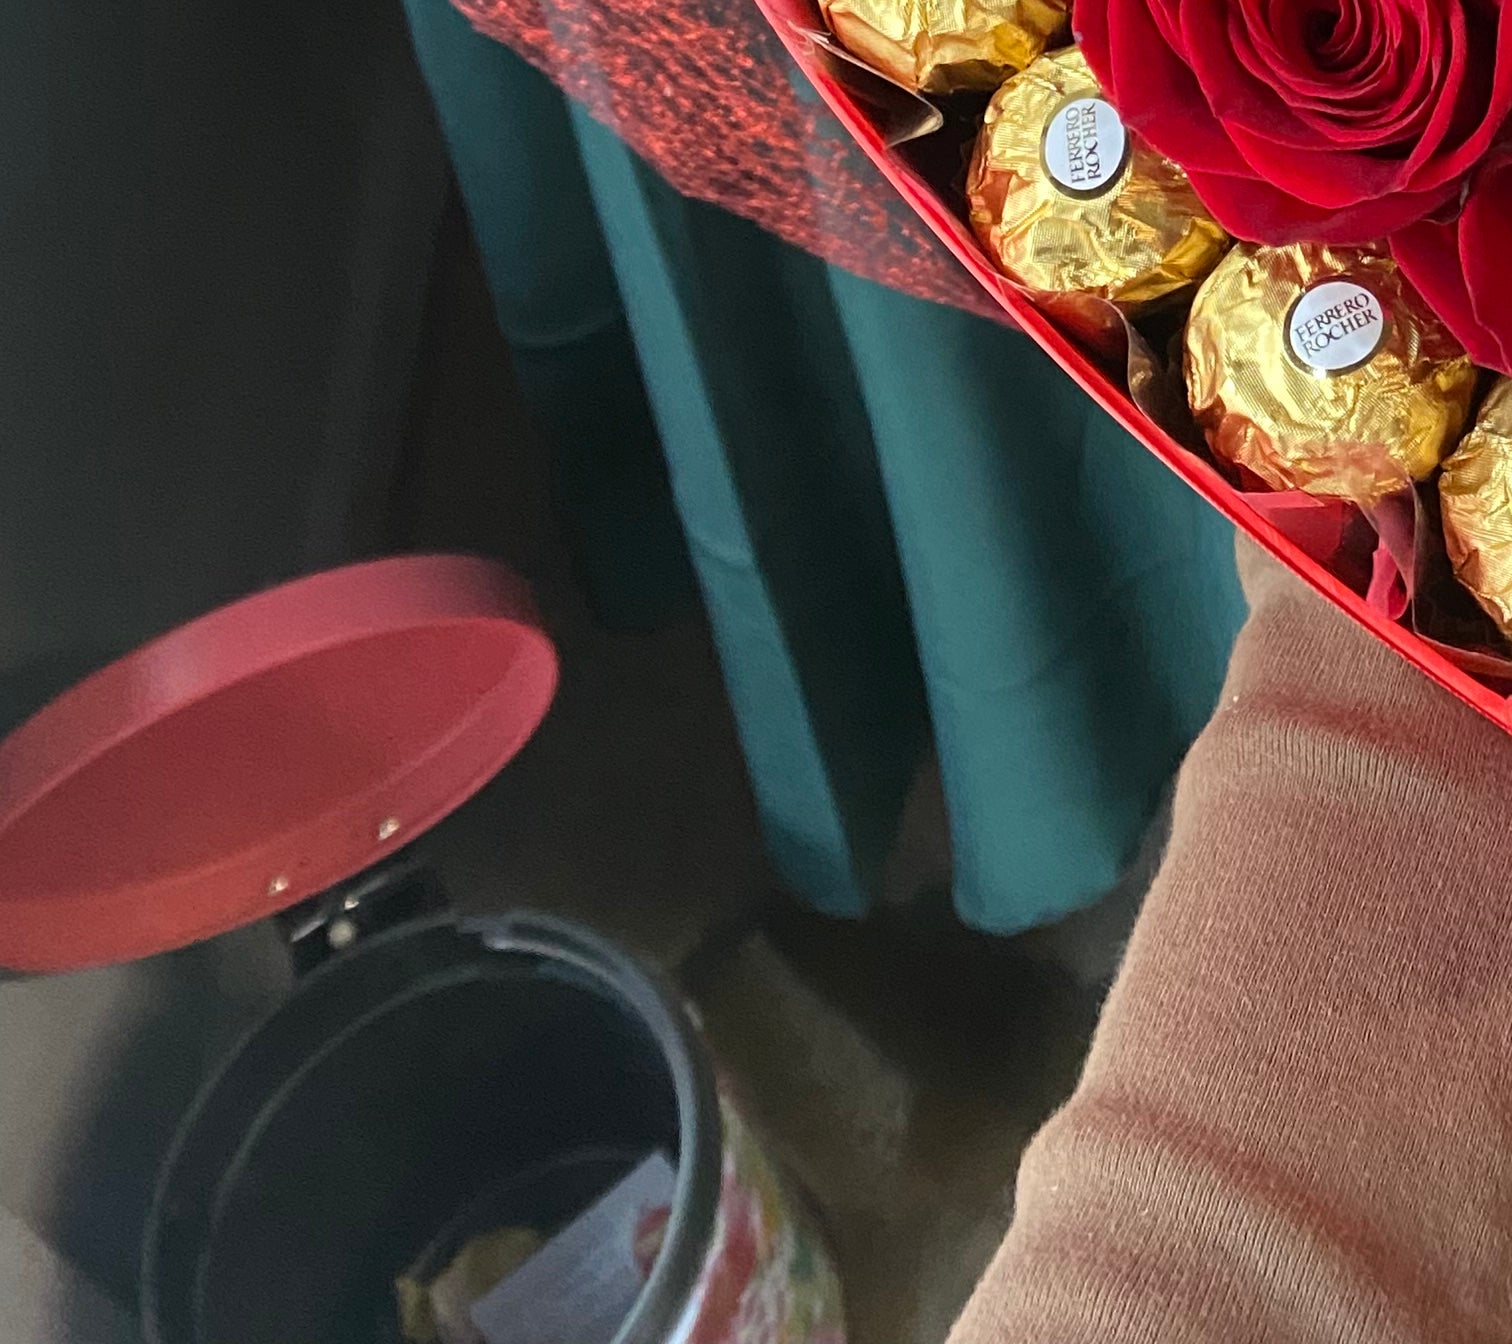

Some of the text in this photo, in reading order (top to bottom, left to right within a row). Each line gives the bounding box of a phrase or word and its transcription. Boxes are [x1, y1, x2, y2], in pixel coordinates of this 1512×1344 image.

[1066, 108, 1085, 183] FERRERO
[1080, 102, 1101, 181] ROCHER
[1295, 293, 1370, 342] FERRERO
[1303, 309, 1379, 358] ROCHER
